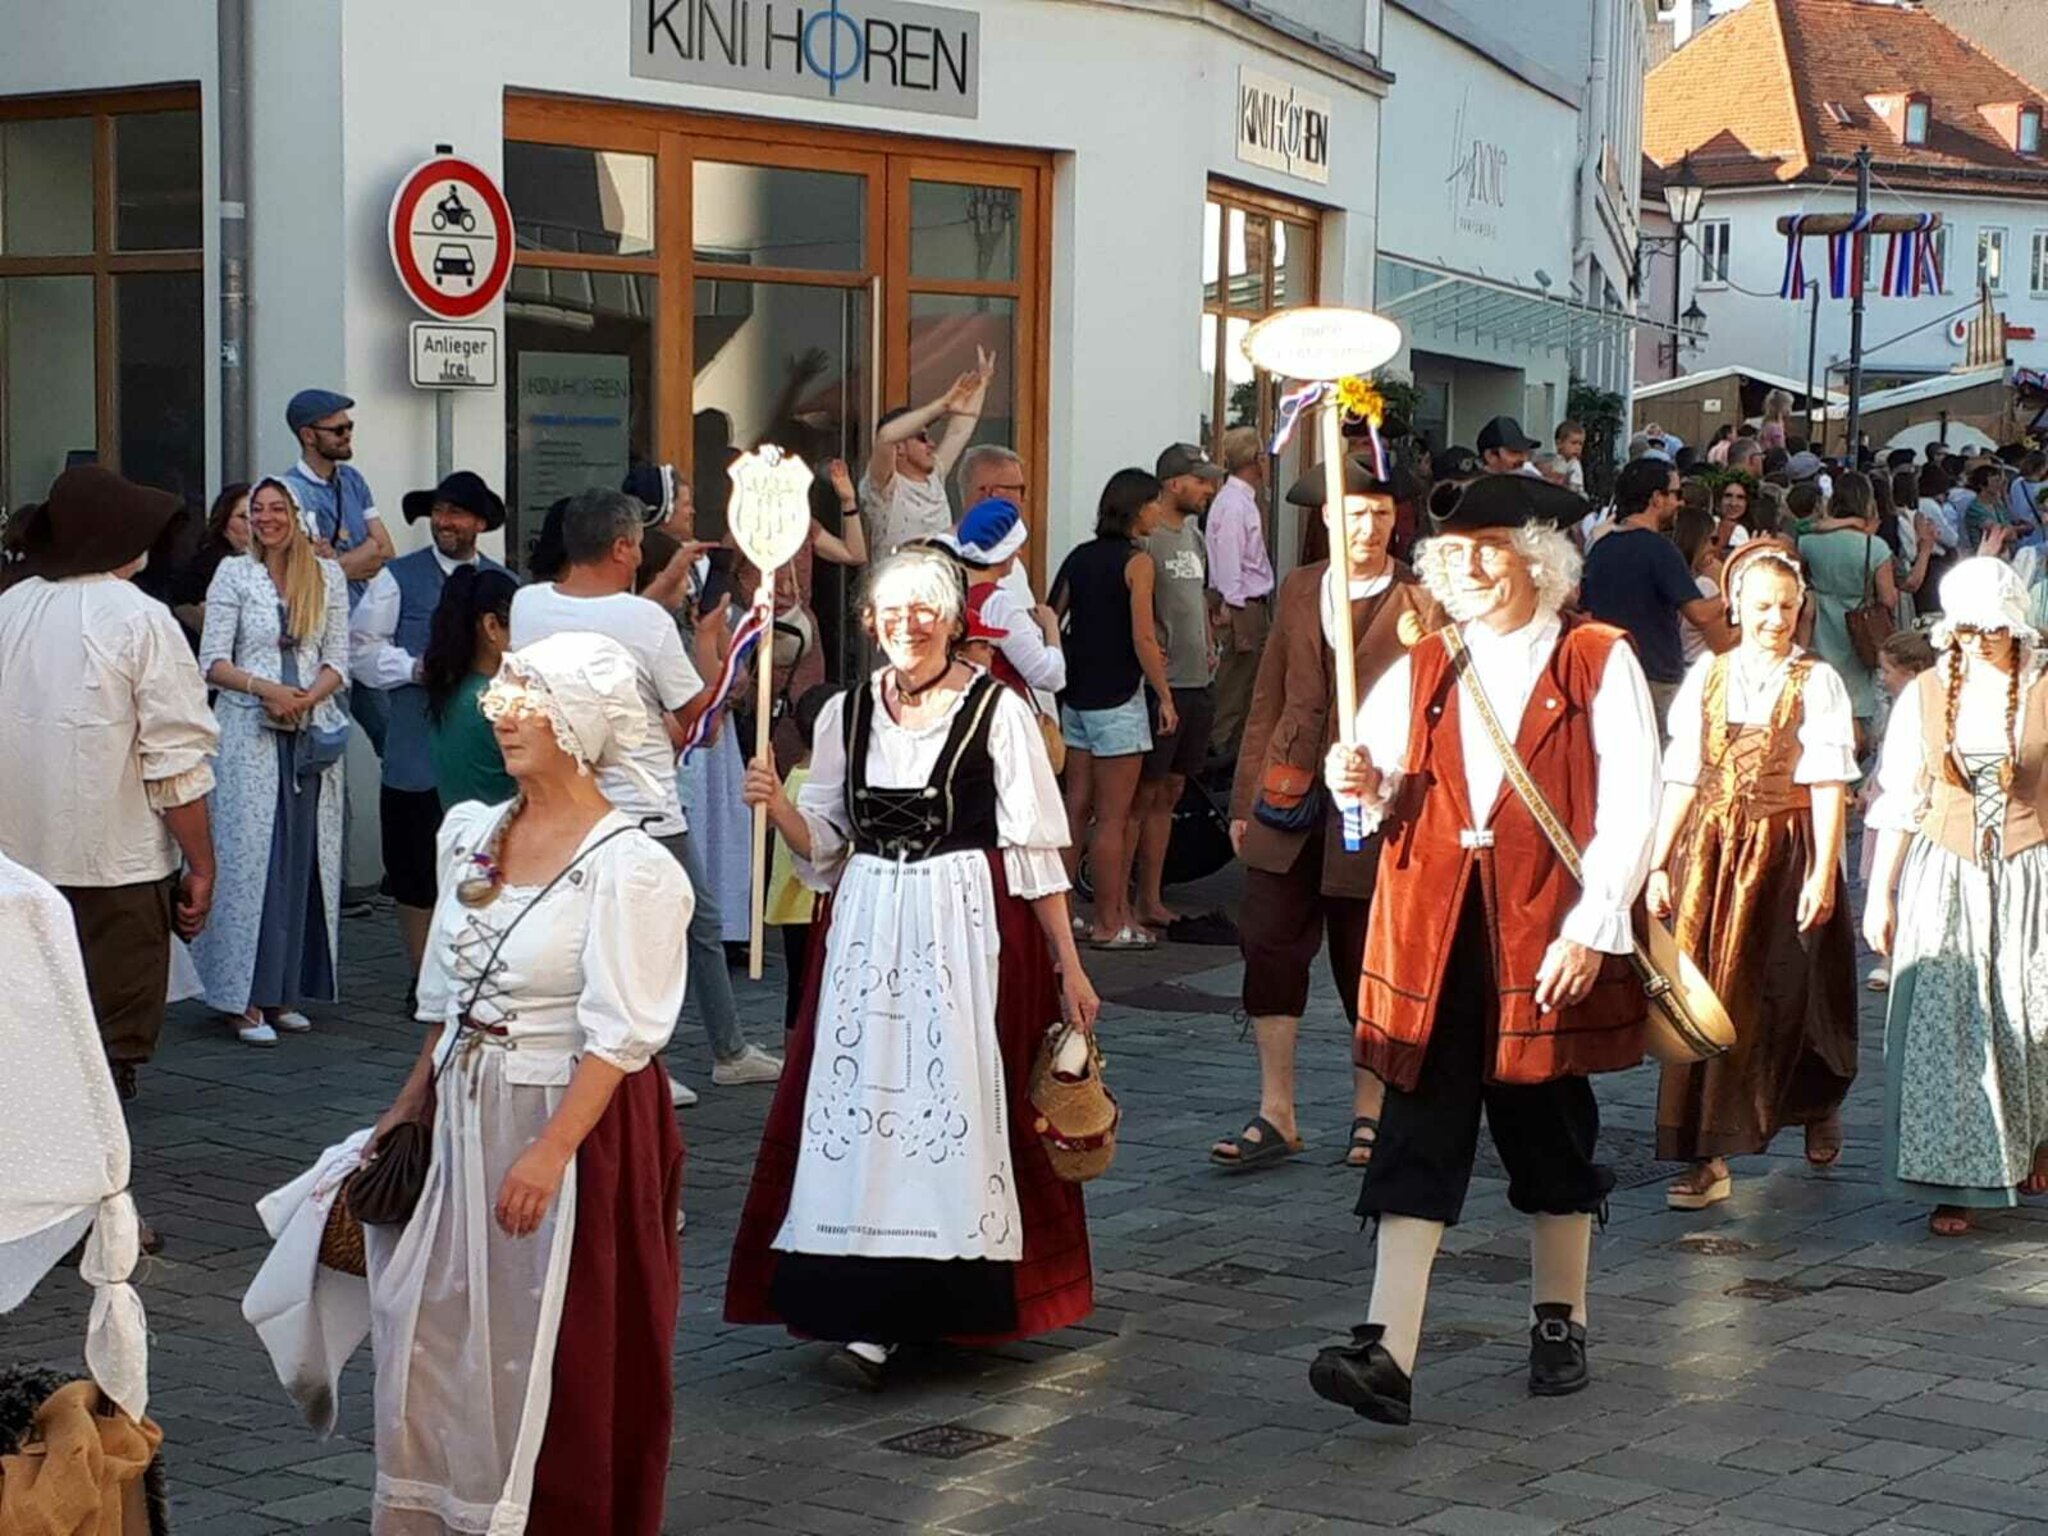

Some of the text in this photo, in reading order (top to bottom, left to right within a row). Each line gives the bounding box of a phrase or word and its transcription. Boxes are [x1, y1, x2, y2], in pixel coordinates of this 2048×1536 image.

[648, 0, 748, 67] KINI
[423, 335, 488, 358] Anlieger
[443, 358, 471, 378] frei
